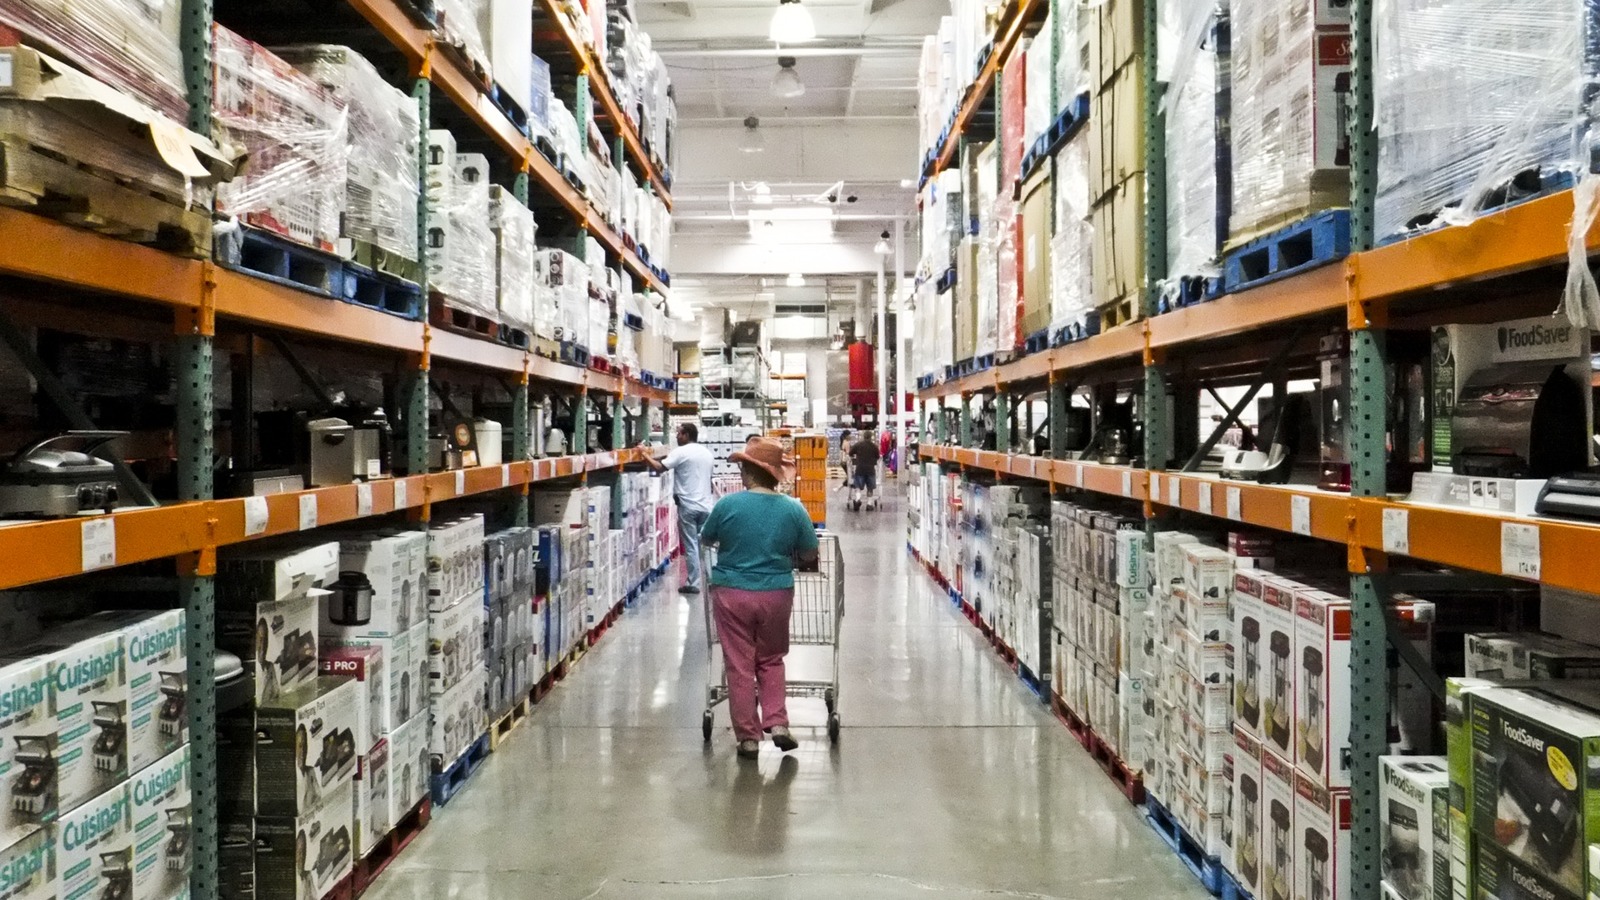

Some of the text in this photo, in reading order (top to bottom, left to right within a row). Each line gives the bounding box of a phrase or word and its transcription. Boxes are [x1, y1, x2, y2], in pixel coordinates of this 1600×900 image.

[1509, 324, 1570, 347] FoodSaver
[1128, 537, 1137, 585] Cuisinart
[129, 620, 185, 663] Cuisinart
[56, 645, 126, 692] Cuisinart
[334, 660, 358, 670] PRO
[0, 670, 56, 717] sinart
[1504, 720, 1544, 753] FoodSaver
[134, 748, 191, 807] Cuisinart
[1391, 768, 1426, 804] FoodSaver
[63, 790, 131, 851] Cuisinart
